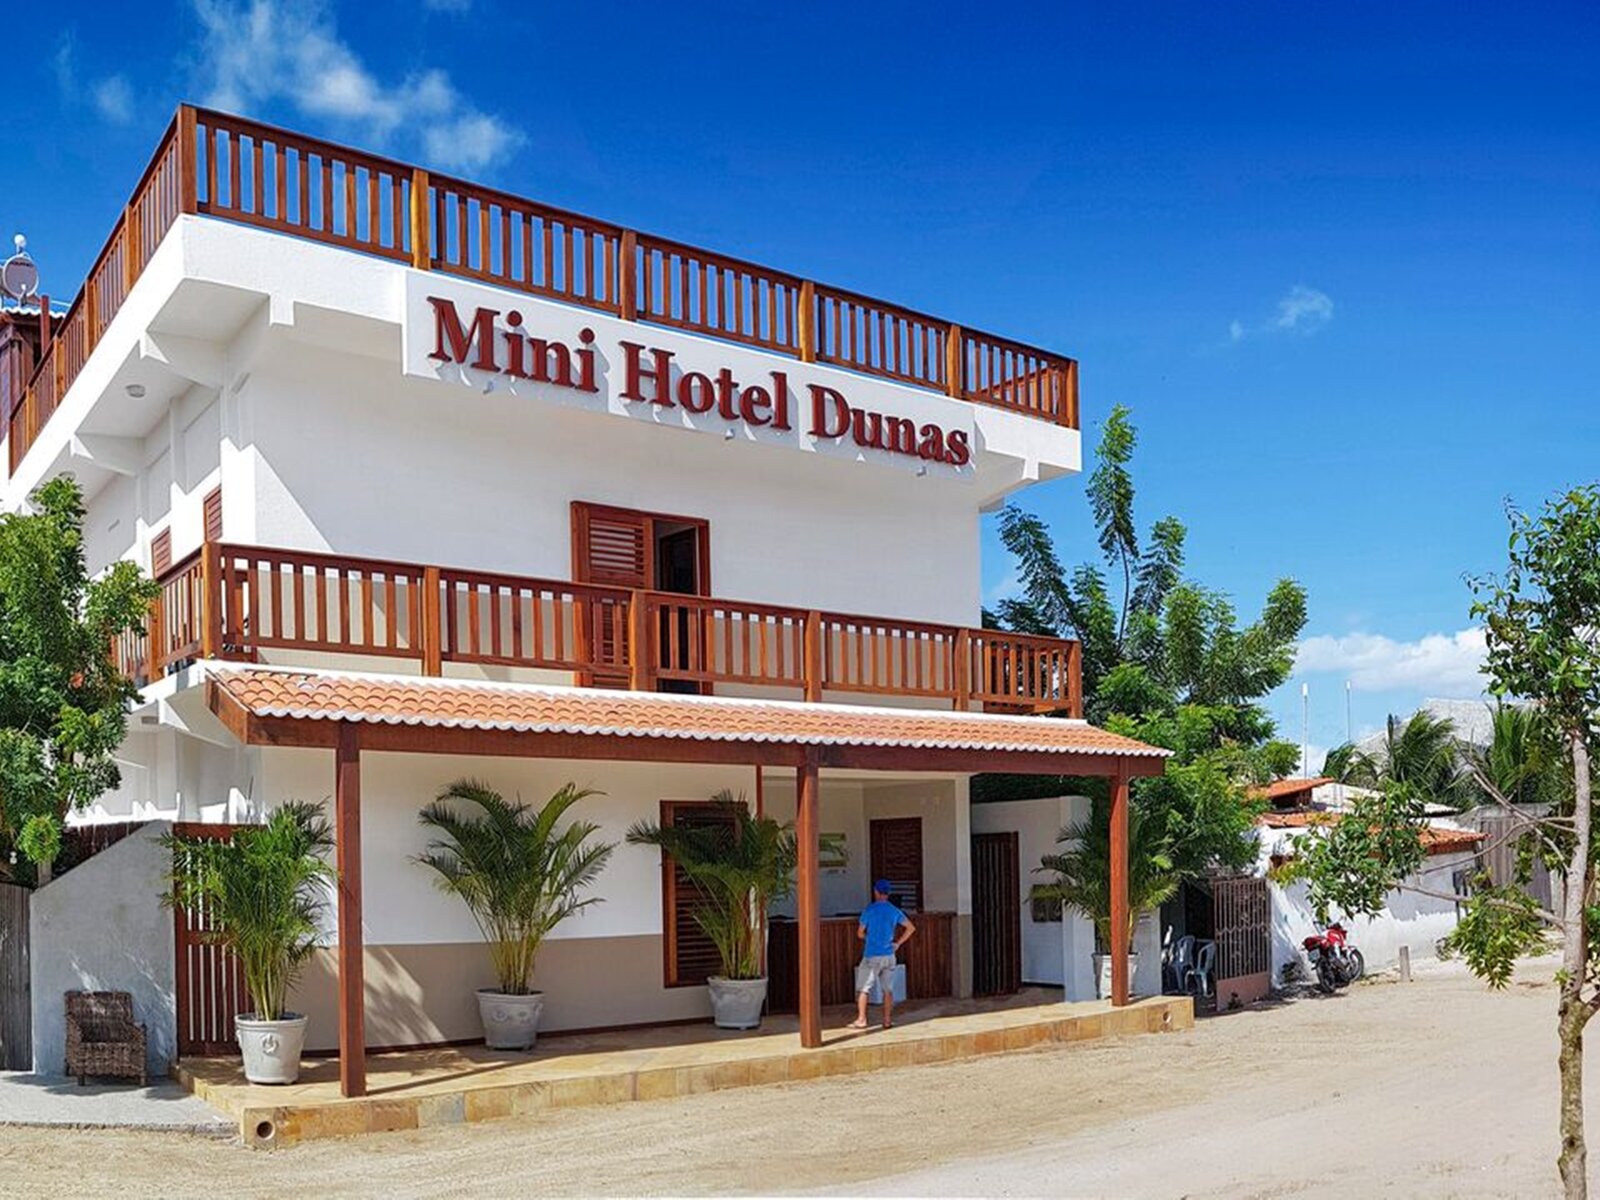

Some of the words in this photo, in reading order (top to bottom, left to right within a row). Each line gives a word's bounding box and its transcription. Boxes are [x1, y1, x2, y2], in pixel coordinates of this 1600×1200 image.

[427, 296, 599, 393] Mini
[619, 340, 792, 431] Hotel
[808, 383, 970, 466] Dunas
